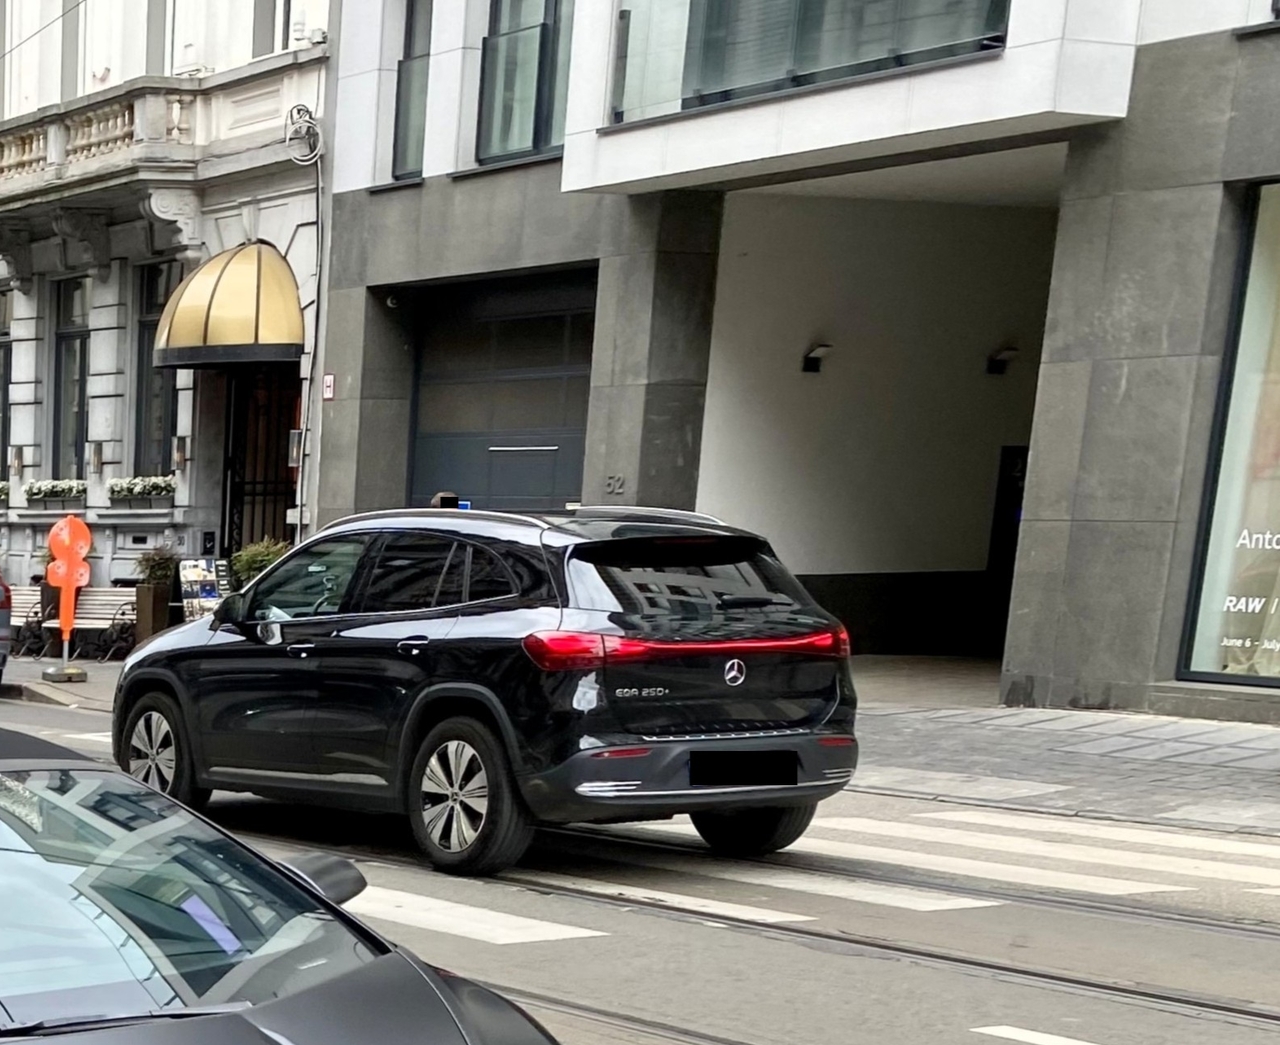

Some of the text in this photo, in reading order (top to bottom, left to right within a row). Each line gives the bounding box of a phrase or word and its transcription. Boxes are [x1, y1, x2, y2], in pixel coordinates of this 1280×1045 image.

[606, 474, 625, 495] 52
[1222, 596, 1267, 614] RAW
[1220, 636, 1243, 648] June
[1244, 637, 1252, 648] 6
